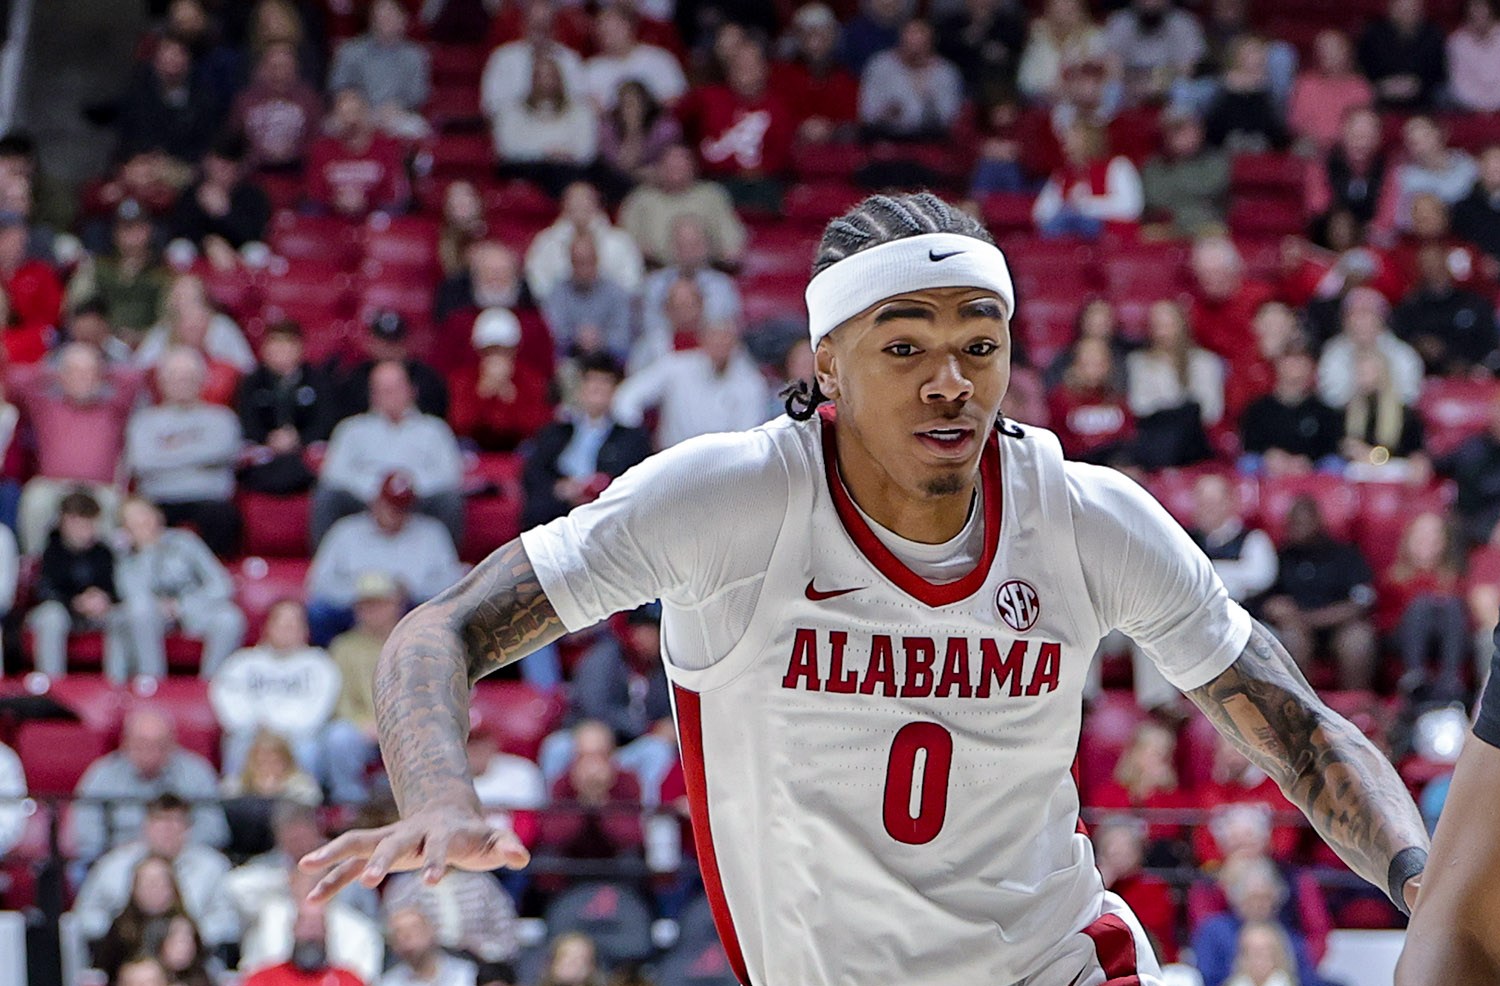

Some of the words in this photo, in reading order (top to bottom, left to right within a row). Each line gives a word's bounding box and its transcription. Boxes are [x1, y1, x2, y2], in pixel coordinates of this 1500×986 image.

[998, 583, 1038, 629] SEC
[782, 628, 1061, 698] ALABAMA
[882, 721, 953, 845] 0
